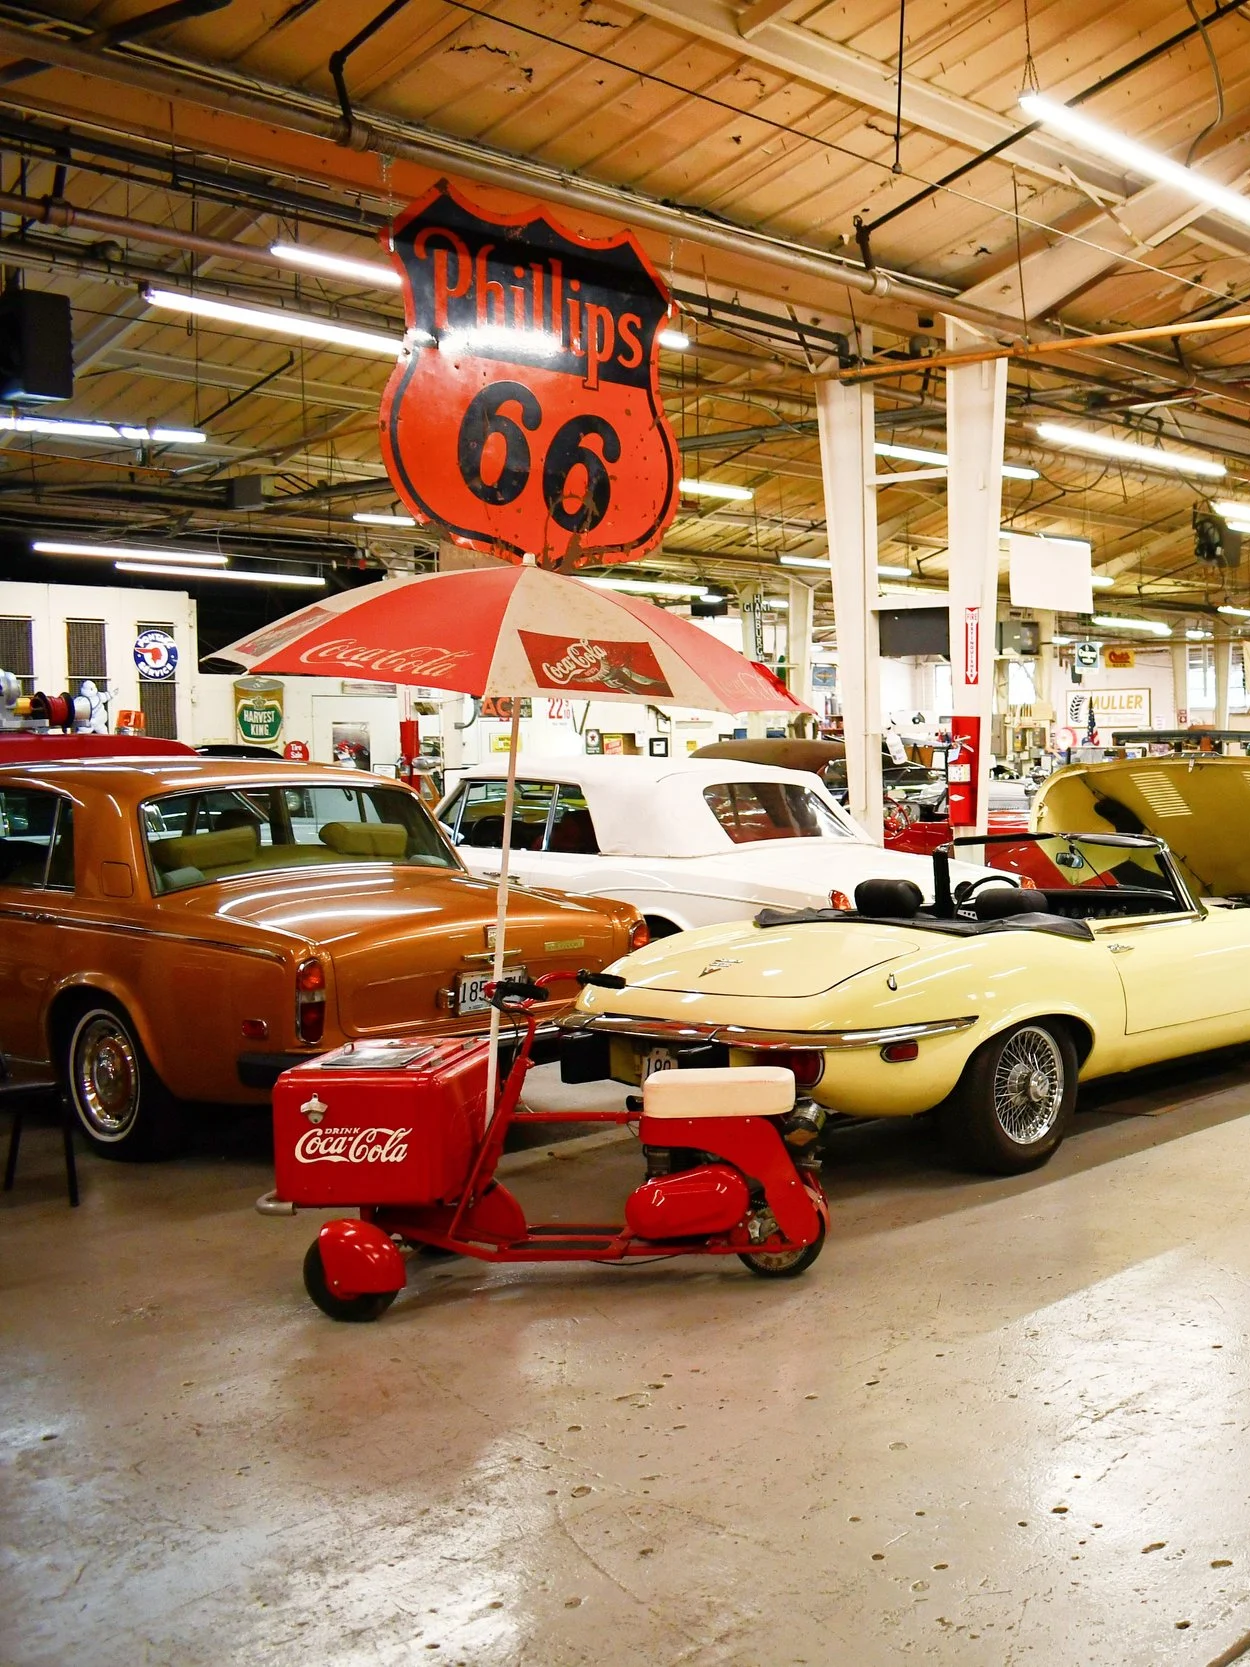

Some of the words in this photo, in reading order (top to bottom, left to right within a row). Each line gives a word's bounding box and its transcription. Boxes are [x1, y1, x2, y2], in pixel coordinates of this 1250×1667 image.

[414, 227, 642, 390] Phillips
[458, 380, 620, 533] 66
[299, 638, 475, 677] Coca-Cola
[541, 638, 607, 684] Coca-Cola
[138, 661, 174, 677] SERVICE
[547, 698, 563, 719] 22
[1087, 695, 1143, 709] MULLER
[243, 709, 276, 723] HARVEST
[250, 724, 270, 736] KING
[291, 751, 303, 759] Sale
[324, 1127, 361, 1135] DRINK
[295, 1128, 413, 1163] Coca-Cola
